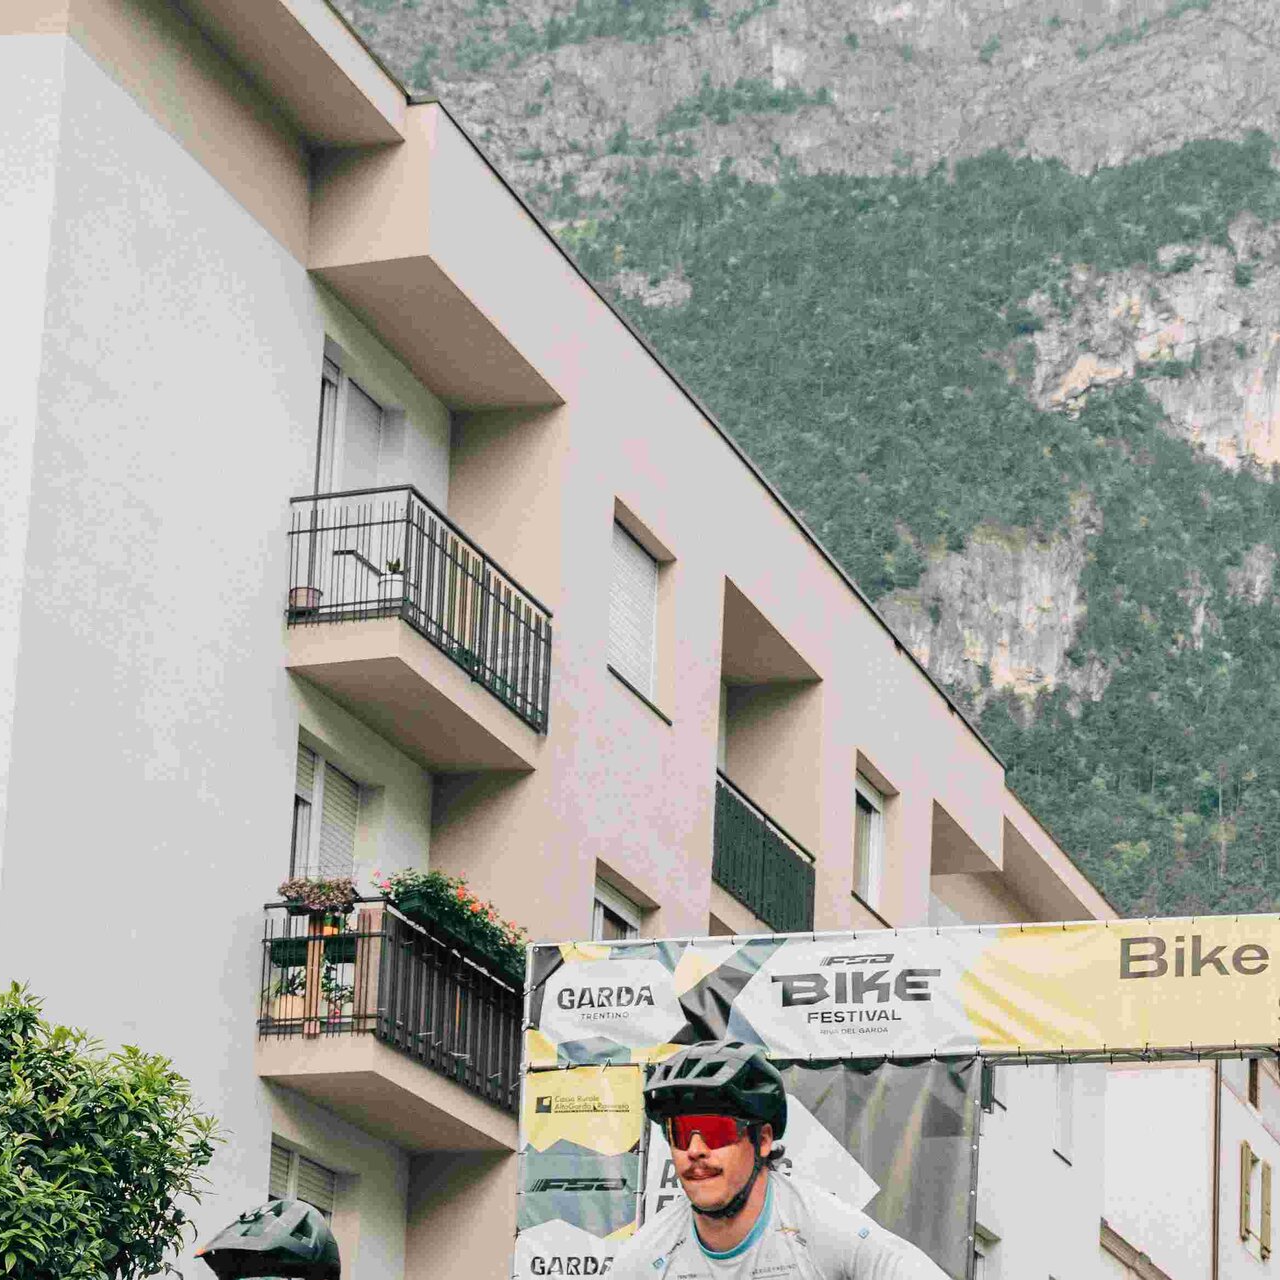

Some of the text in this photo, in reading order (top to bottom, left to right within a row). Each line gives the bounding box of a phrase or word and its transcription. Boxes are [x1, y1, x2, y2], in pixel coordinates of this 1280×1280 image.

[1119, 932, 1270, 981] Bike
[557, 984, 655, 1010] GARDA
[771, 968, 942, 1008] BIKE
[580, 1011, 629, 1021] TRENTINO
[806, 1009, 902, 1025] FESTIVAL
[840, 1027, 858, 1035] DEL
[858, 1026, 889, 1034] GARDA
